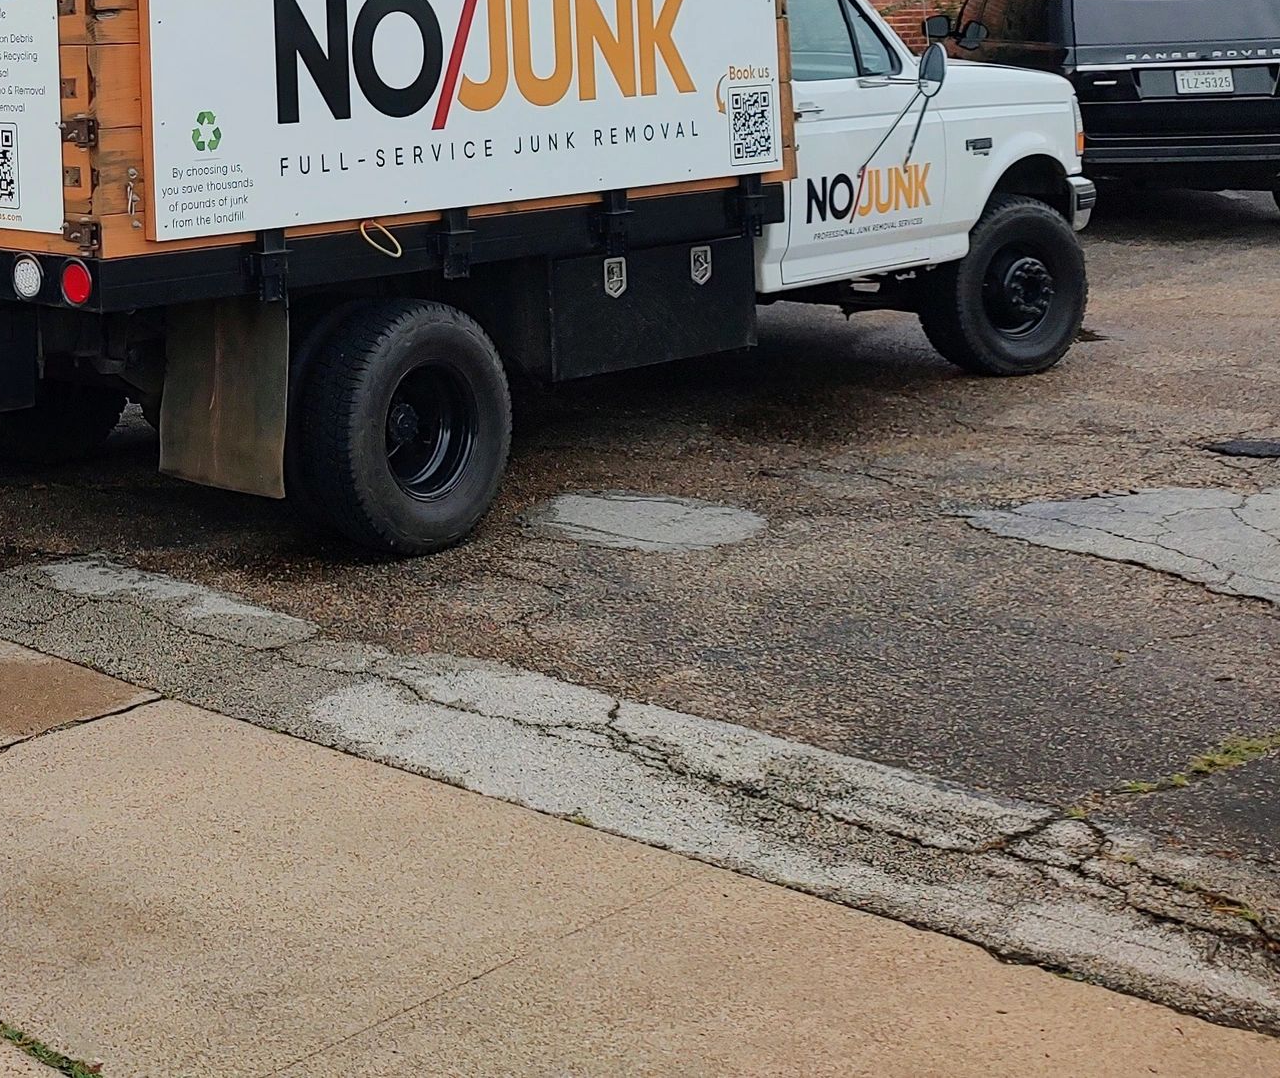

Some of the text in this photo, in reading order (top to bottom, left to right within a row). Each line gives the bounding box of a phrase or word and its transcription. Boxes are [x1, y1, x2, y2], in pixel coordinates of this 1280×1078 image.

[10, 33, 34, 43] Debris
[3, 51, 38, 62] Recycling
[1125, 48, 1280, 61] RANGE ROVER
[729, 65, 770, 81] Book us
[7, 85, 13, 95] &
[14, 85, 46, 95] Removal
[279, 120, 700, 177] FULL-SERVICE JUNK REMOVAL
[172, 163, 244, 180] By choosing us,
[161, 178, 254, 198] you save thousands
[168, 194, 249, 213] of pounds of junk
[172, 217, 194, 229] from
[196, 214, 211, 226] the
